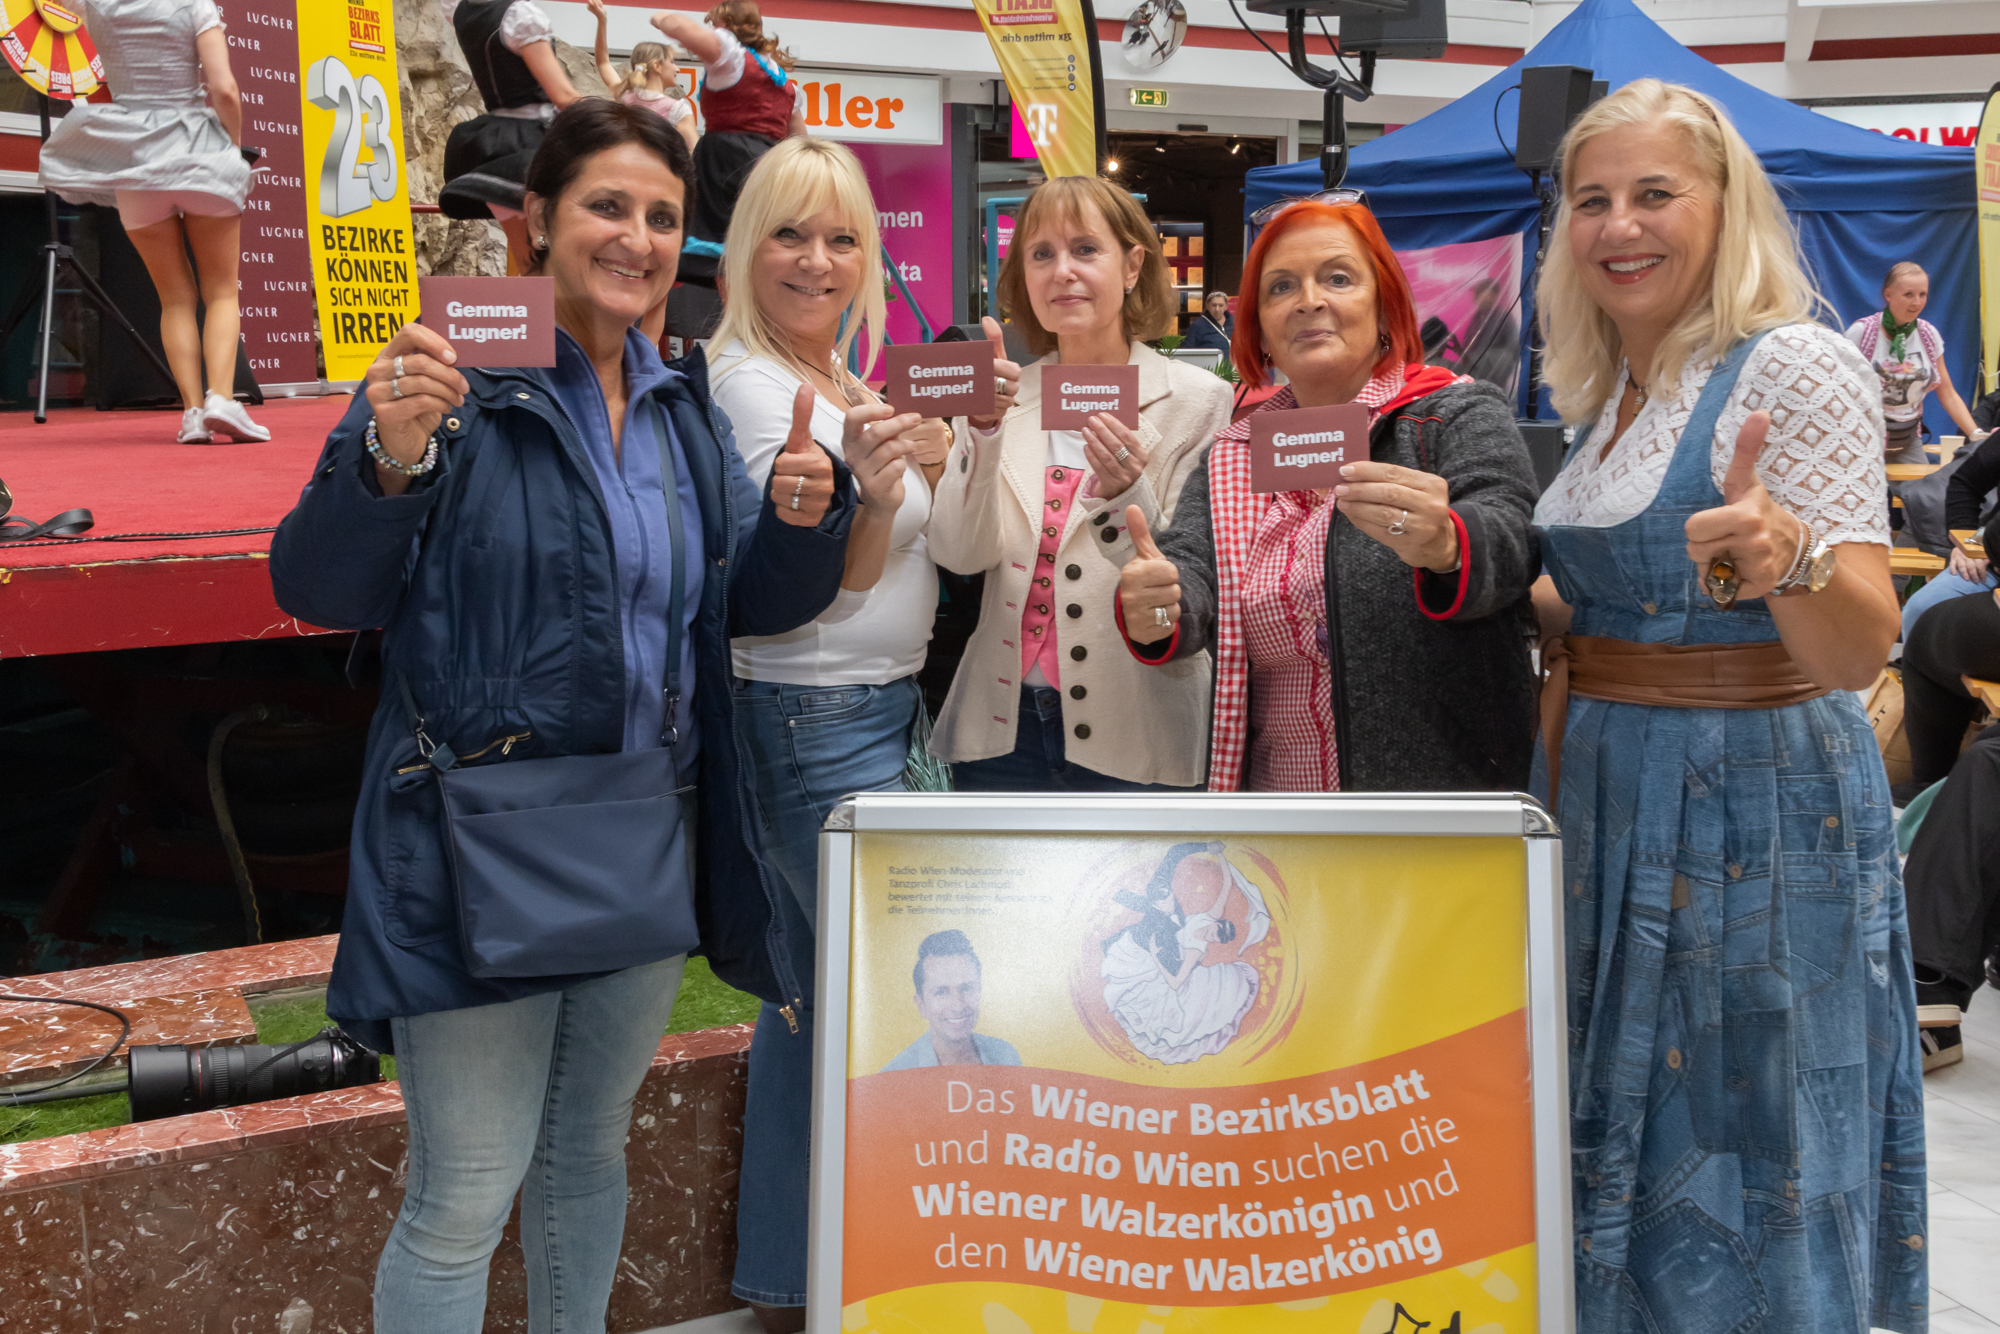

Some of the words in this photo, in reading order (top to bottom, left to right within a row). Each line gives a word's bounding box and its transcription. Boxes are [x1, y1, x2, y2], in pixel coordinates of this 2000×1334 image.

[247, 11, 293, 31] LUGNER
[348, 5, 380, 24] BEZIRKS
[349, 20, 381, 43] BLATT
[228, 35, 261, 52] GNER
[250, 66, 296, 84] LUGNER
[241, 92, 264, 105] NER
[788, 79, 904, 130] ller
[253, 120, 299, 136] LUGNER
[307, 56, 398, 218] 23
[257, 173, 302, 188] LUGNER
[260, 226, 304, 239] LUGNER
[322, 224, 405, 254] BEZIRKE
[242, 251, 274, 264] GNER
[326, 252, 408, 283] KÖNNEN
[264, 281, 307, 292] LUGNER
[330, 287, 363, 307] SICH
[367, 288, 409, 307] NICHT
[238, 306, 278, 317] UGNER
[446, 301, 528, 317] Gemma
[332, 312, 404, 344] IRREN
[448, 324, 527, 343] Lugner!
[267, 331, 311, 343] LUGNER
[249, 358, 280, 369] GNER
[909, 365, 975, 379] Gemma
[910, 380, 974, 398] Lugner!
[1060, 382, 1120, 394] Gemma
[1061, 398, 1120, 413] Lugner!
[1272, 430, 1345, 447] Gemma
[1274, 447, 1344, 468] Lugner!
[888, 866, 917, 876] Radio
[887, 892, 933, 901] bewertet
[947, 1080, 1015, 1115] Das
[1031, 1083, 1178, 1135] Wiener
[1190, 1069, 1431, 1136] Bezirksblatt
[915, 1129, 989, 1167] und
[1004, 1132, 1122, 1180] Radio
[1134, 1150, 1240, 1188] Wien
[1253, 1138, 1389, 1186] suchen
[1400, 1112, 1460, 1156] die
[912, 1180, 1068, 1222] Wiener
[1081, 1187, 1375, 1239] Walzerkönigin
[1385, 1159, 1460, 1213] und
[935, 1231, 1007, 1269] den
[1024, 1236, 1174, 1290] Wiener
[1184, 1224, 1443, 1292] Walzerkönig
